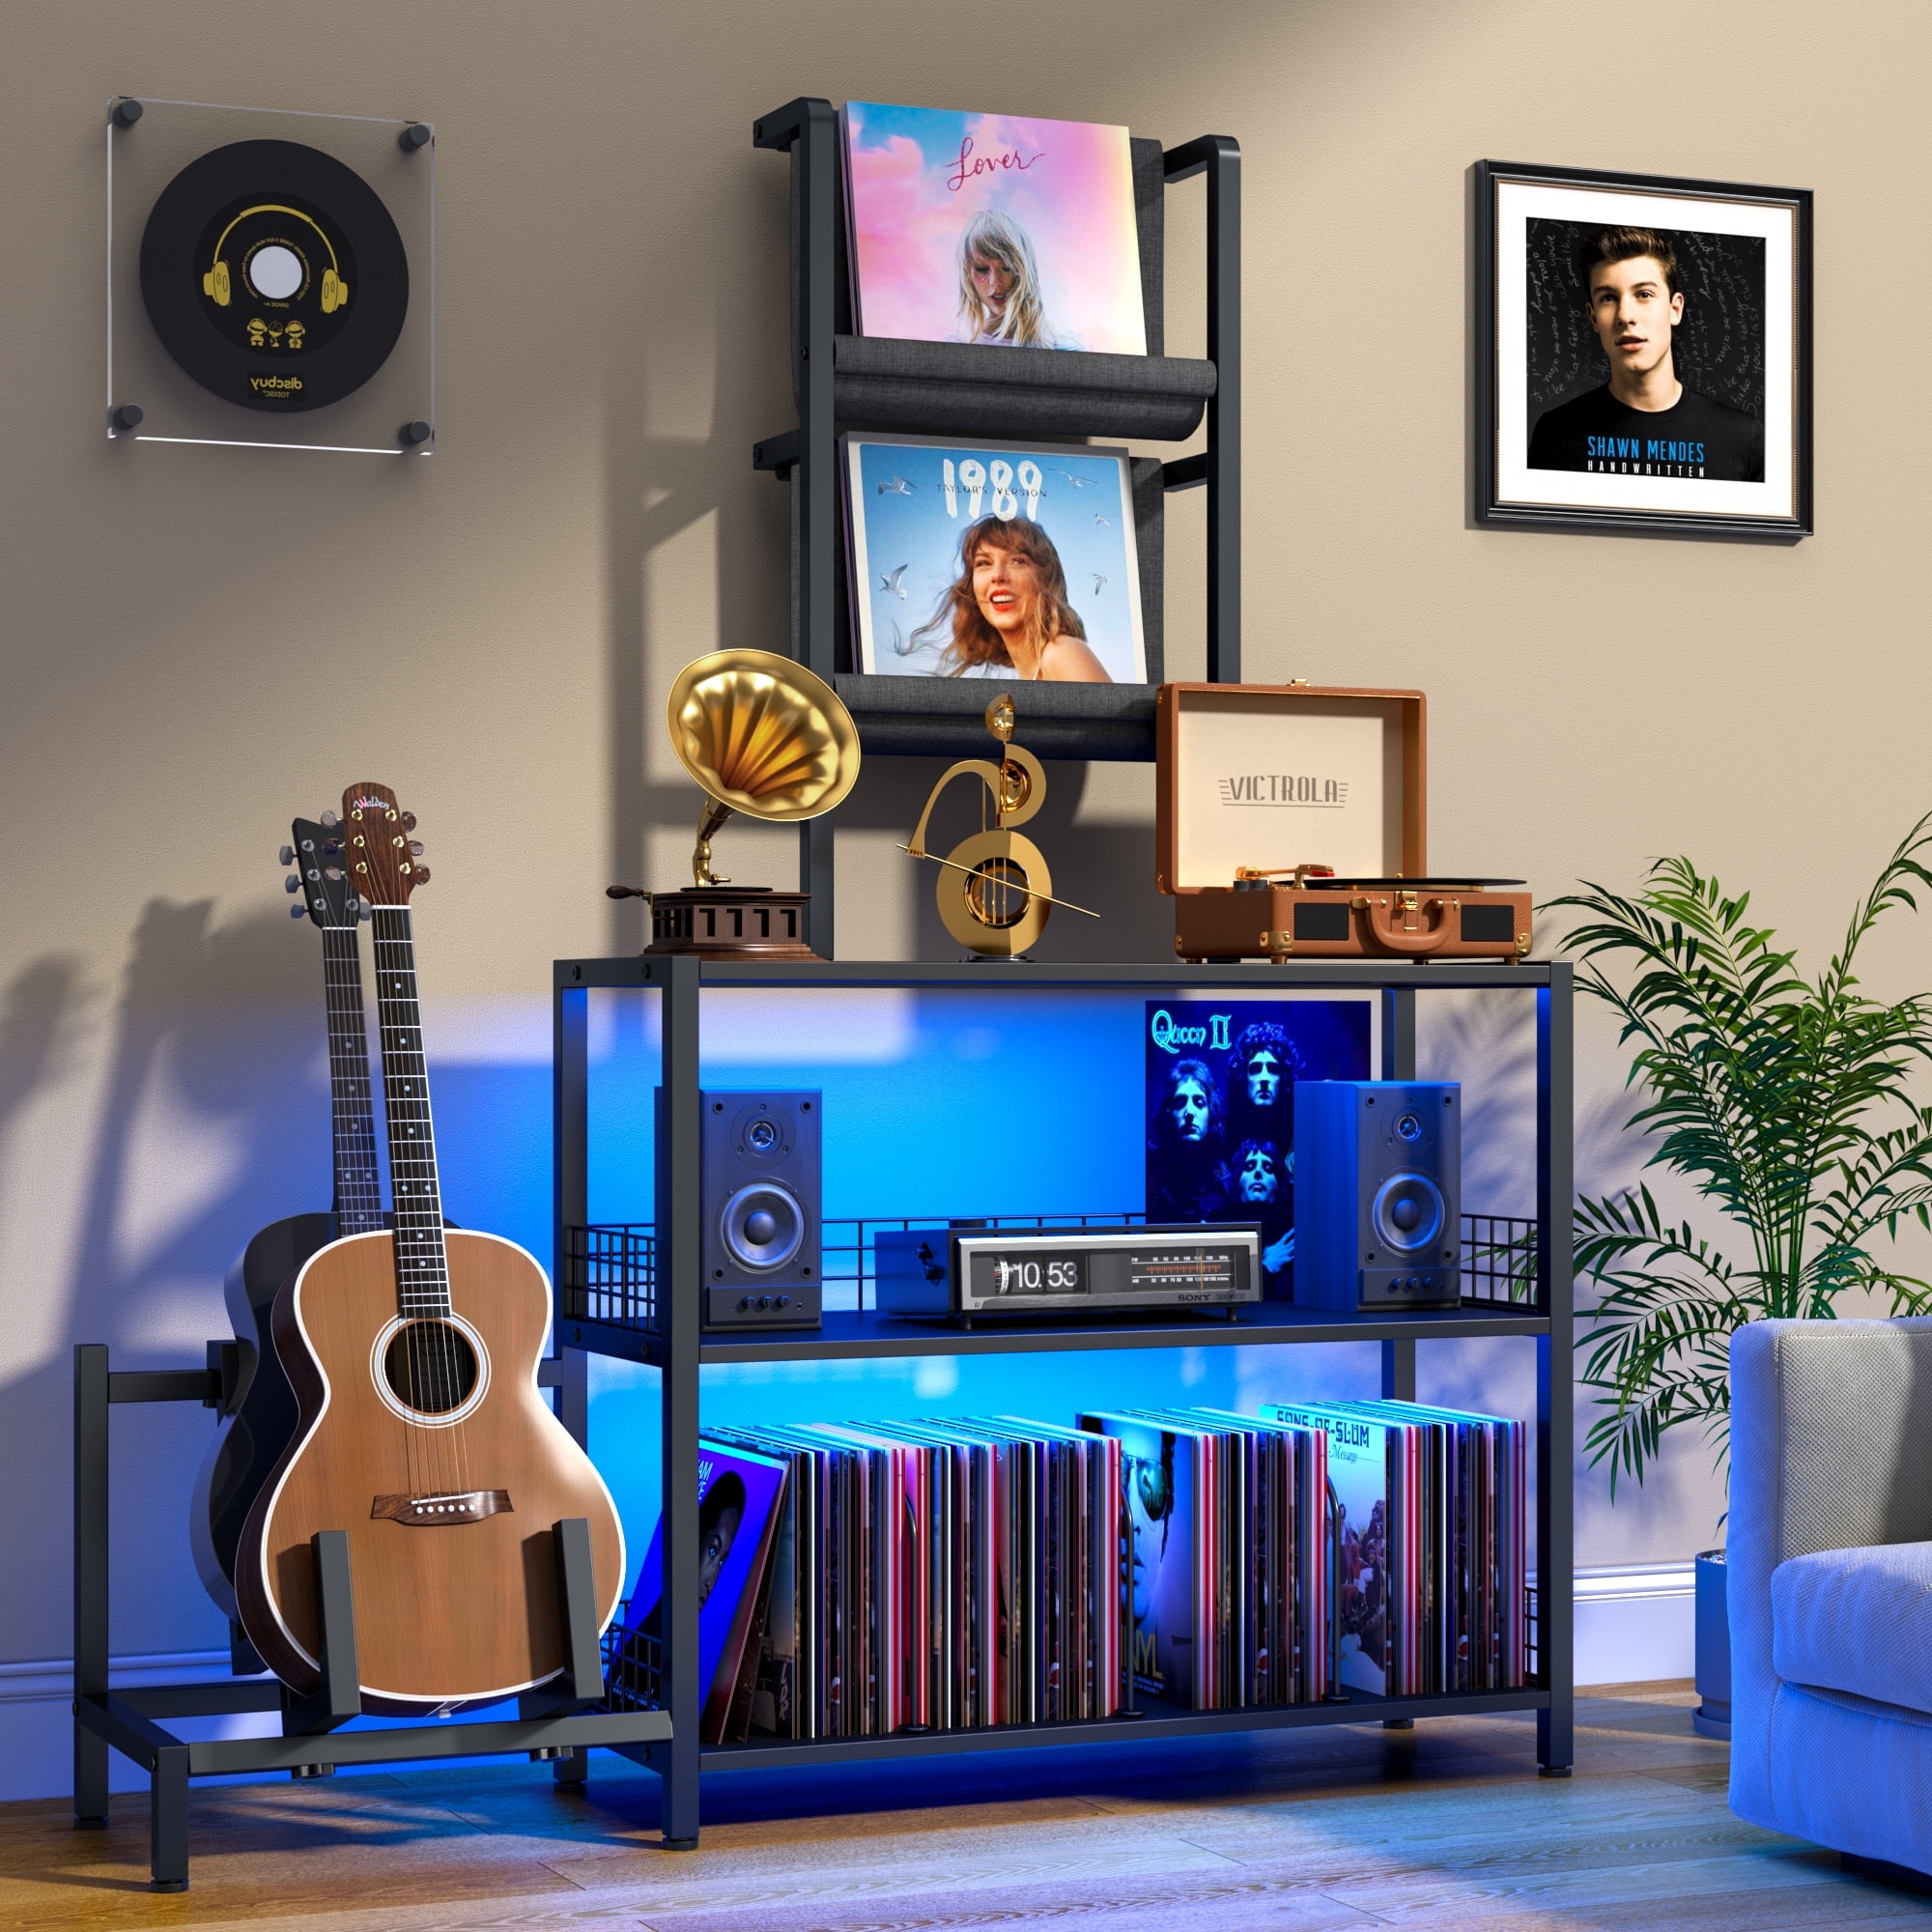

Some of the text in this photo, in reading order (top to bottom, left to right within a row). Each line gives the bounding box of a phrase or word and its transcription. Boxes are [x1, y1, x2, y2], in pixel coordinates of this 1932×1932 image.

[943, 136, 1047, 191] Lover
[1588, 436, 1704, 463] SHAWN MENDES
[1588, 460, 1704, 478] HANDWRITTEN
[936, 484, 1047, 497] TAYLOR'S VERSION
[943, 458, 1043, 522] 1989
[1228, 775, 1339, 803] VICTROLA
[353, 796, 390, 810] Walden
[1151, 1009, 1206, 1054] Queen
